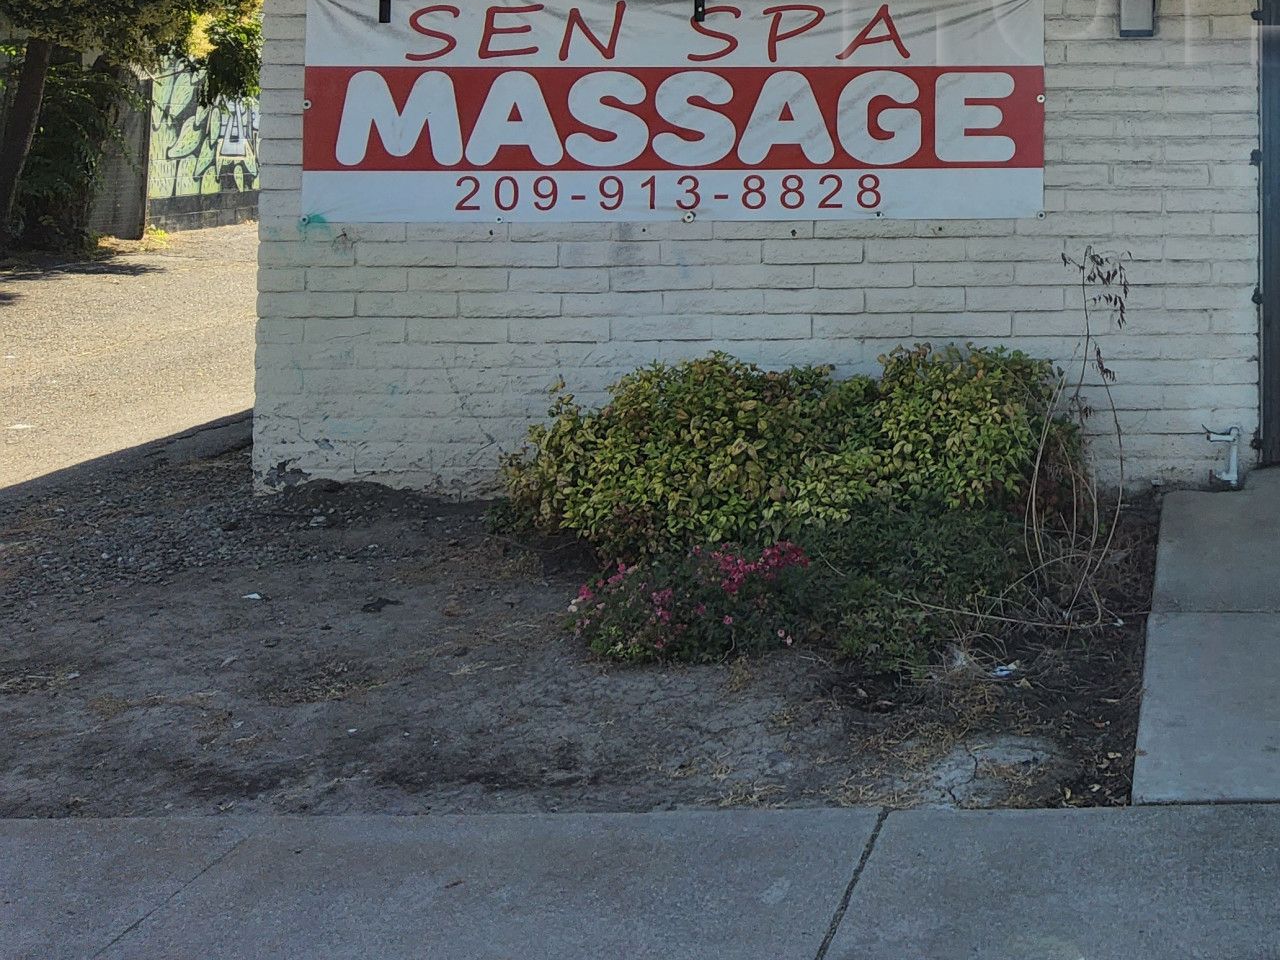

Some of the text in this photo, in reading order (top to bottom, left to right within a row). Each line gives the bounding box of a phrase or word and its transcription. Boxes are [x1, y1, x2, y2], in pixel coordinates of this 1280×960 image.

[405, 0, 911, 63] SEN SPA
[334, 69, 1017, 168] MASSAGE
[454, 172, 884, 213] 209-913-8828
